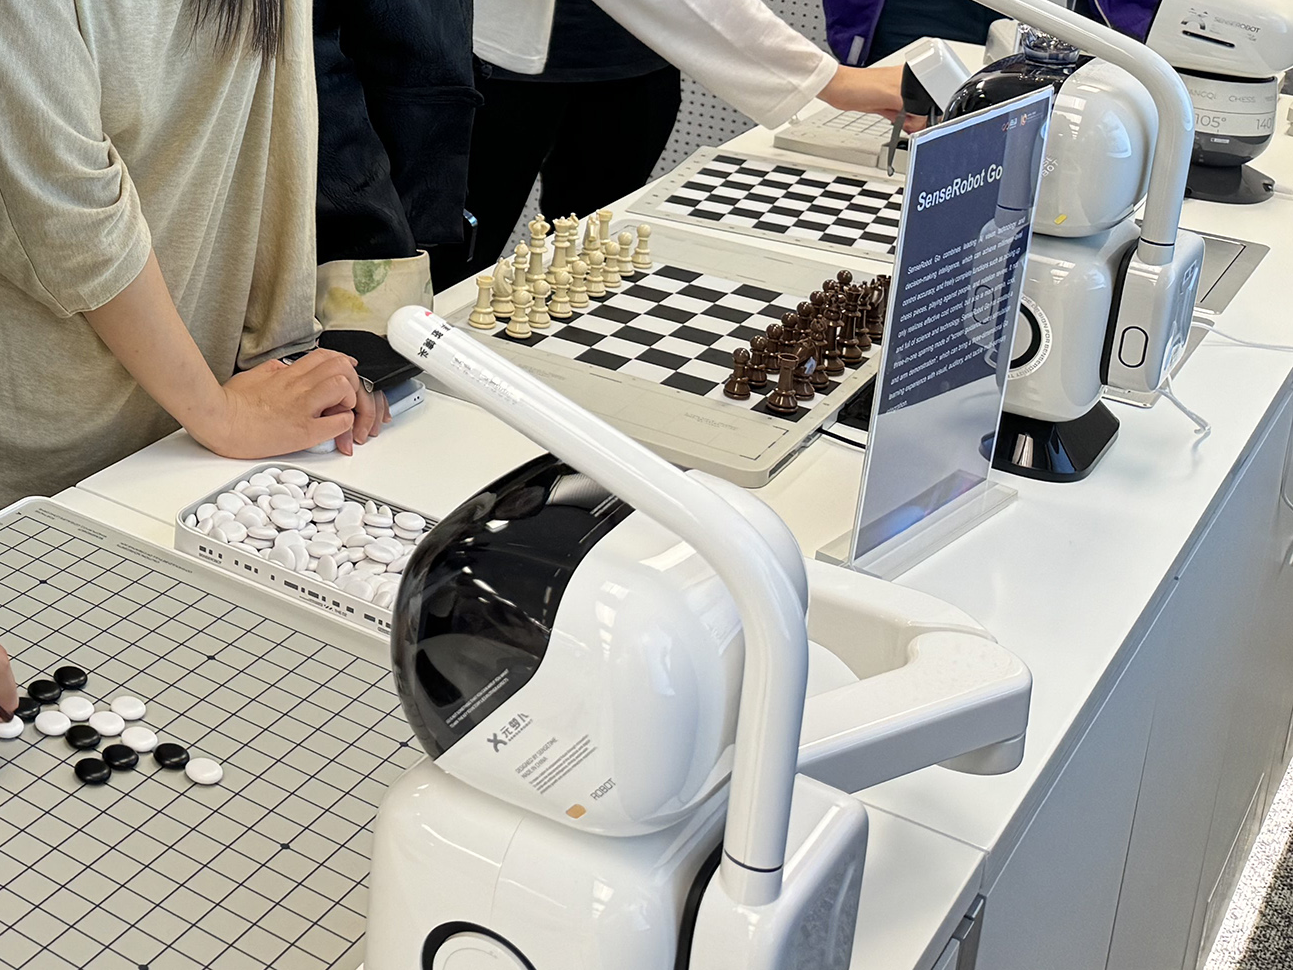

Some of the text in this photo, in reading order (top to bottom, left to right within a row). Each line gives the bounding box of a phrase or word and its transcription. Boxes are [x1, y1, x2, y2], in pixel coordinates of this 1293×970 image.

[917, 164, 1003, 211] SenseRobot Go
[590, 778, 616, 800] ROBOT
